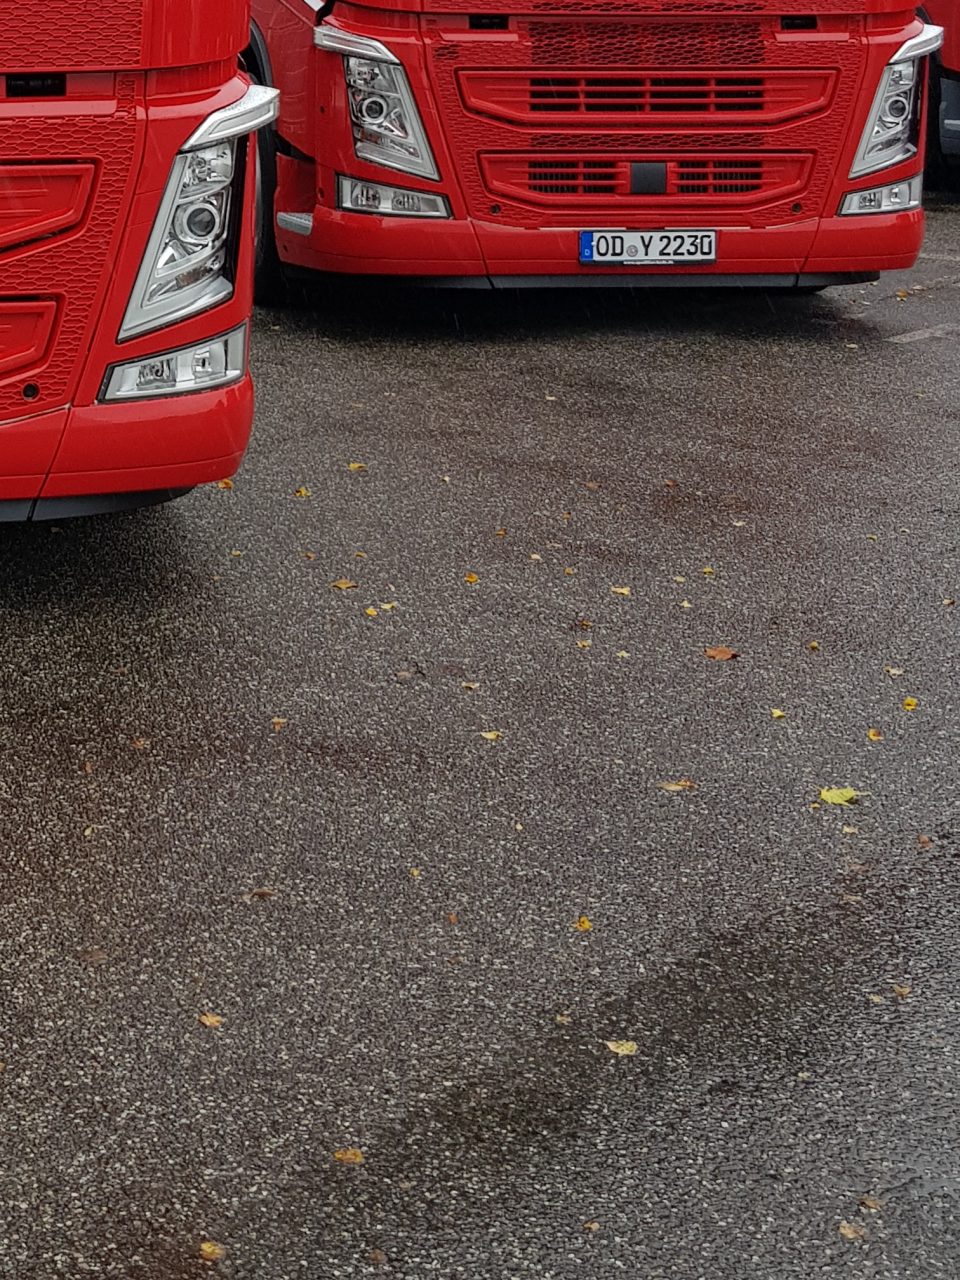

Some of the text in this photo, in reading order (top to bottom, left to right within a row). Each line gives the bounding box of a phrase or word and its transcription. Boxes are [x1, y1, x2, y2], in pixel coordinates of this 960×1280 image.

[596, 235, 713, 257] OD Y 2230
